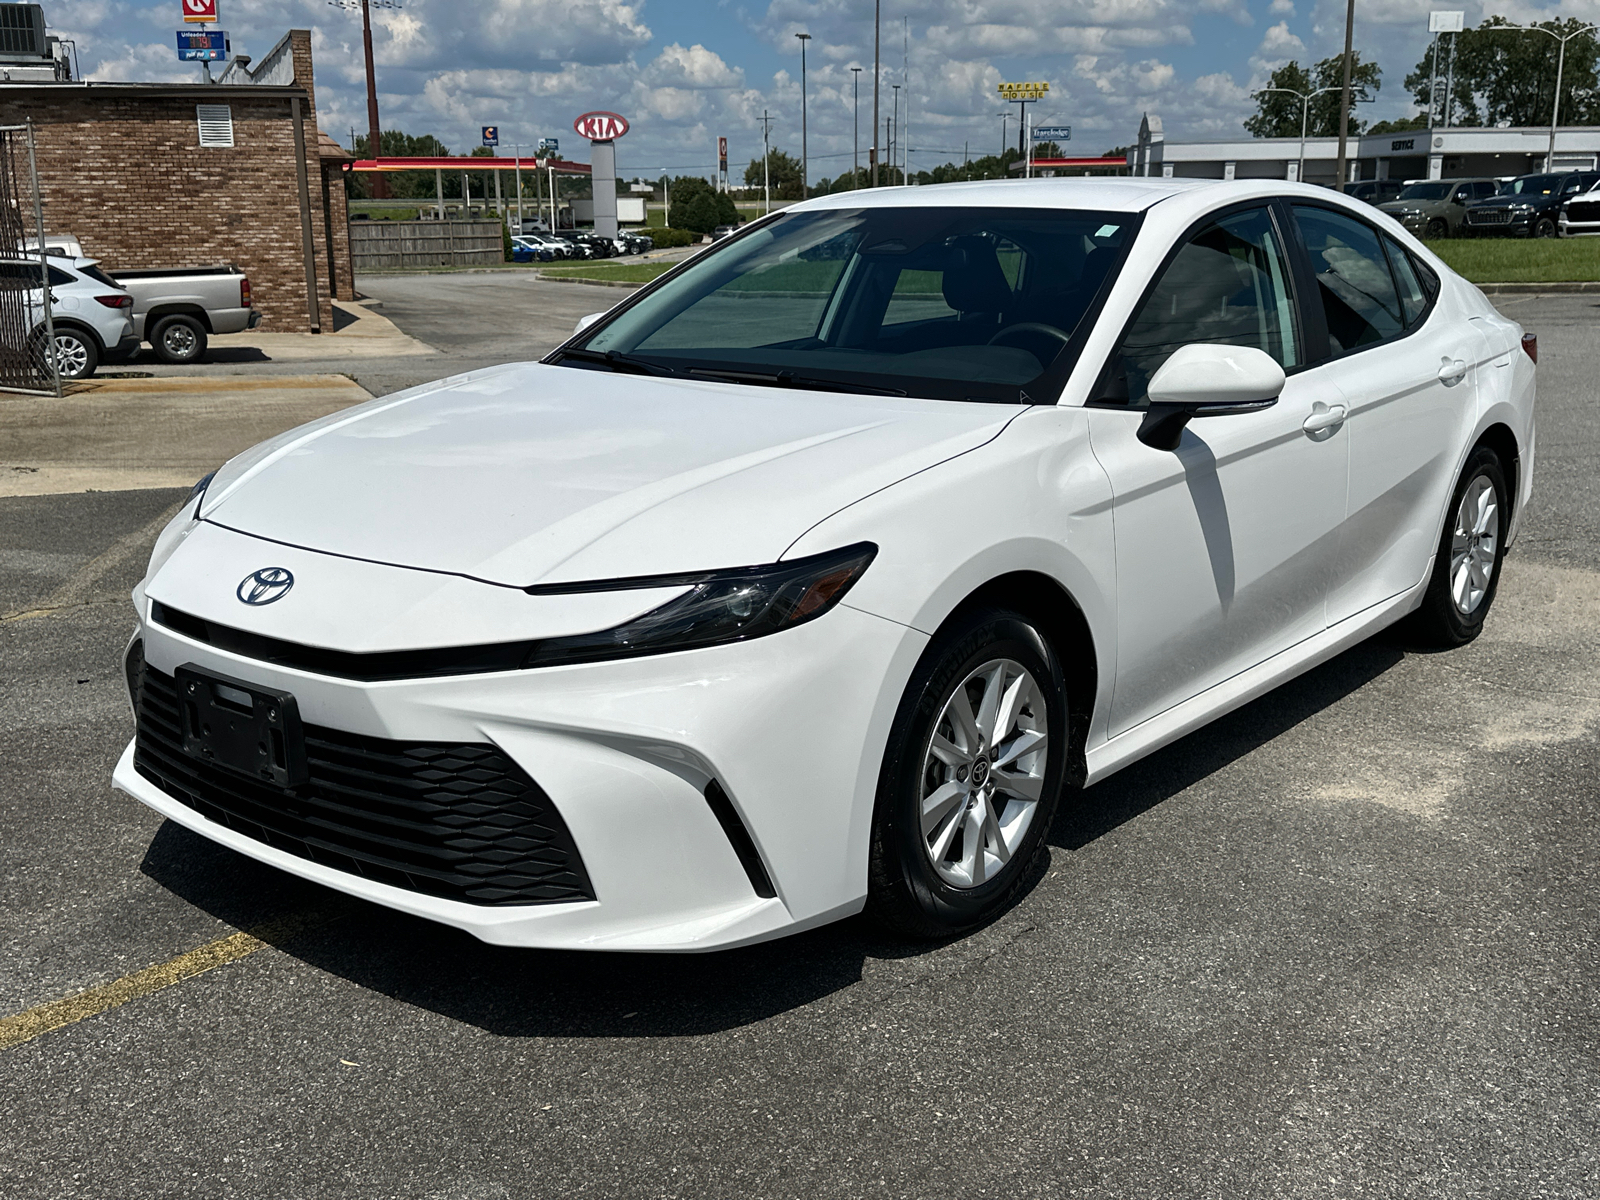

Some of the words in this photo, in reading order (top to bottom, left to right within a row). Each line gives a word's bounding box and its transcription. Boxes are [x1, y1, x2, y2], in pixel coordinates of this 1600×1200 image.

[998, 83, 1049, 91] WAFFLE
[1002, 91, 1044, 99] HOUSE
[583, 117, 619, 137] KIA
[1391, 139, 1415, 151] SERVICE
